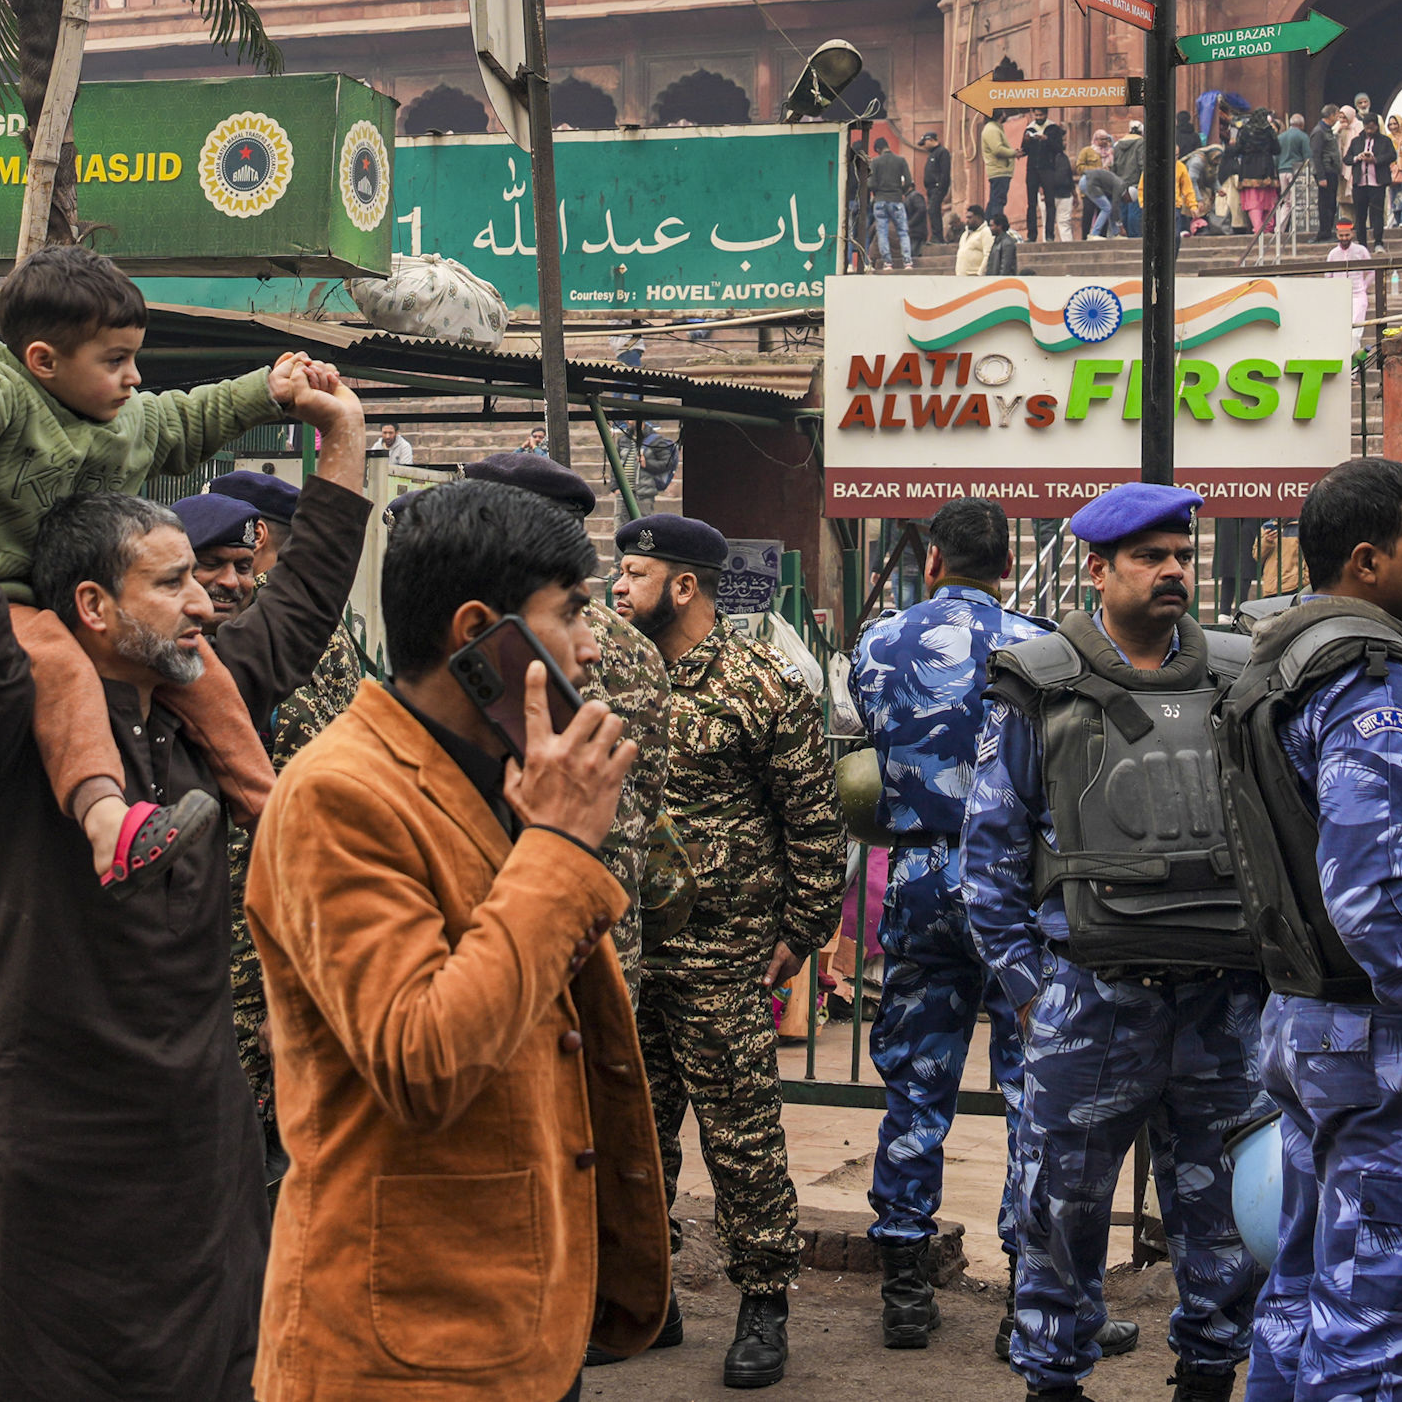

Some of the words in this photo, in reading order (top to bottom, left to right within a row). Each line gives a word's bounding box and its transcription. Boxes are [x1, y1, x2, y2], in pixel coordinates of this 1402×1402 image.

[1131, 3, 1152, 22] MAHAL
[1201, 31, 1233, 47] URDU
[1236, 27, 1275, 43] BAZAR
[1211, 44, 1237, 59] FAIZ
[1239, 41, 1272, 57] ROAD
[989, 87, 1039, 100] CHAWRI
[77, 152, 183, 184] ASJID
[710, 194, 826, 272] باب
[569, 289, 614, 303] Courtesy
[721, 281, 824, 300] AUTOGAS
[1064, 358, 1344, 423] FIRST
[838, 394, 1059, 429] ALWAYS
[833, 482, 901, 498] BAZAR
[906, 482, 966, 498] MATIA
[970, 482, 1040, 498] MAHAL
[1044, 483, 1123, 498] TRADE
